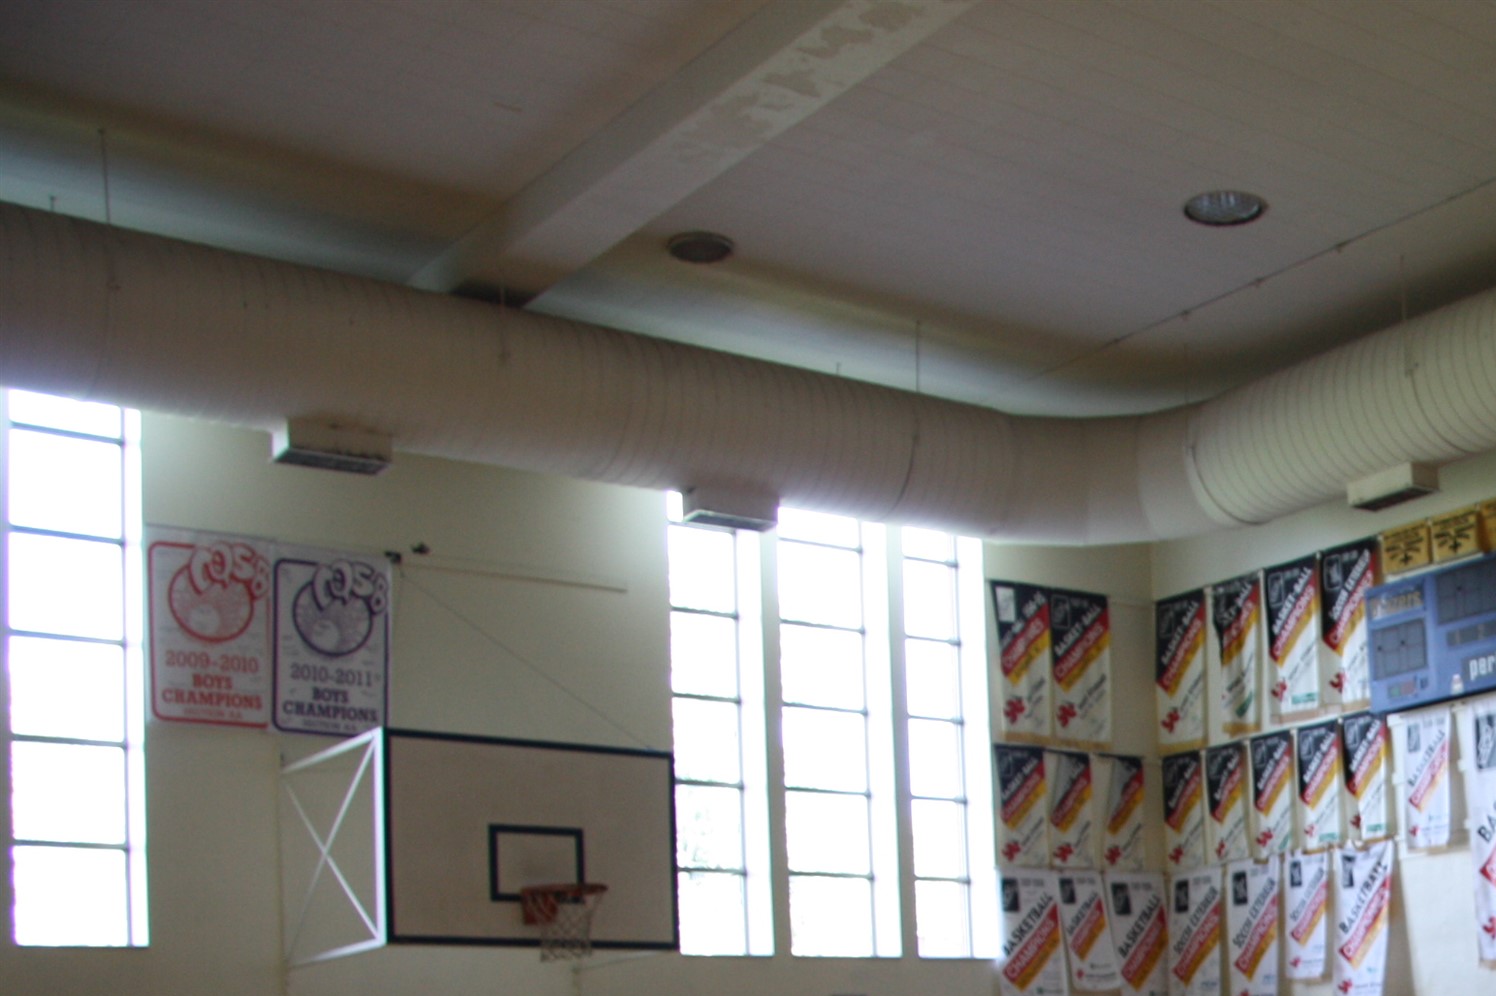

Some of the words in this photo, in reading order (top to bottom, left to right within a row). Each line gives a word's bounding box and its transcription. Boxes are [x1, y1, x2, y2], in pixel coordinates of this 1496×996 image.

[1272, 584, 1315, 656] CHAMPIONS
[165, 649, 260, 675] 2009-2010
[192, 673, 233, 690] BOYS
[290, 662, 374, 687] 2010-2011
[161, 688, 263, 711] CHAMPIONS
[312, 686, 349, 703] BOYS
[282, 701, 379, 723] CHAMPIONS
